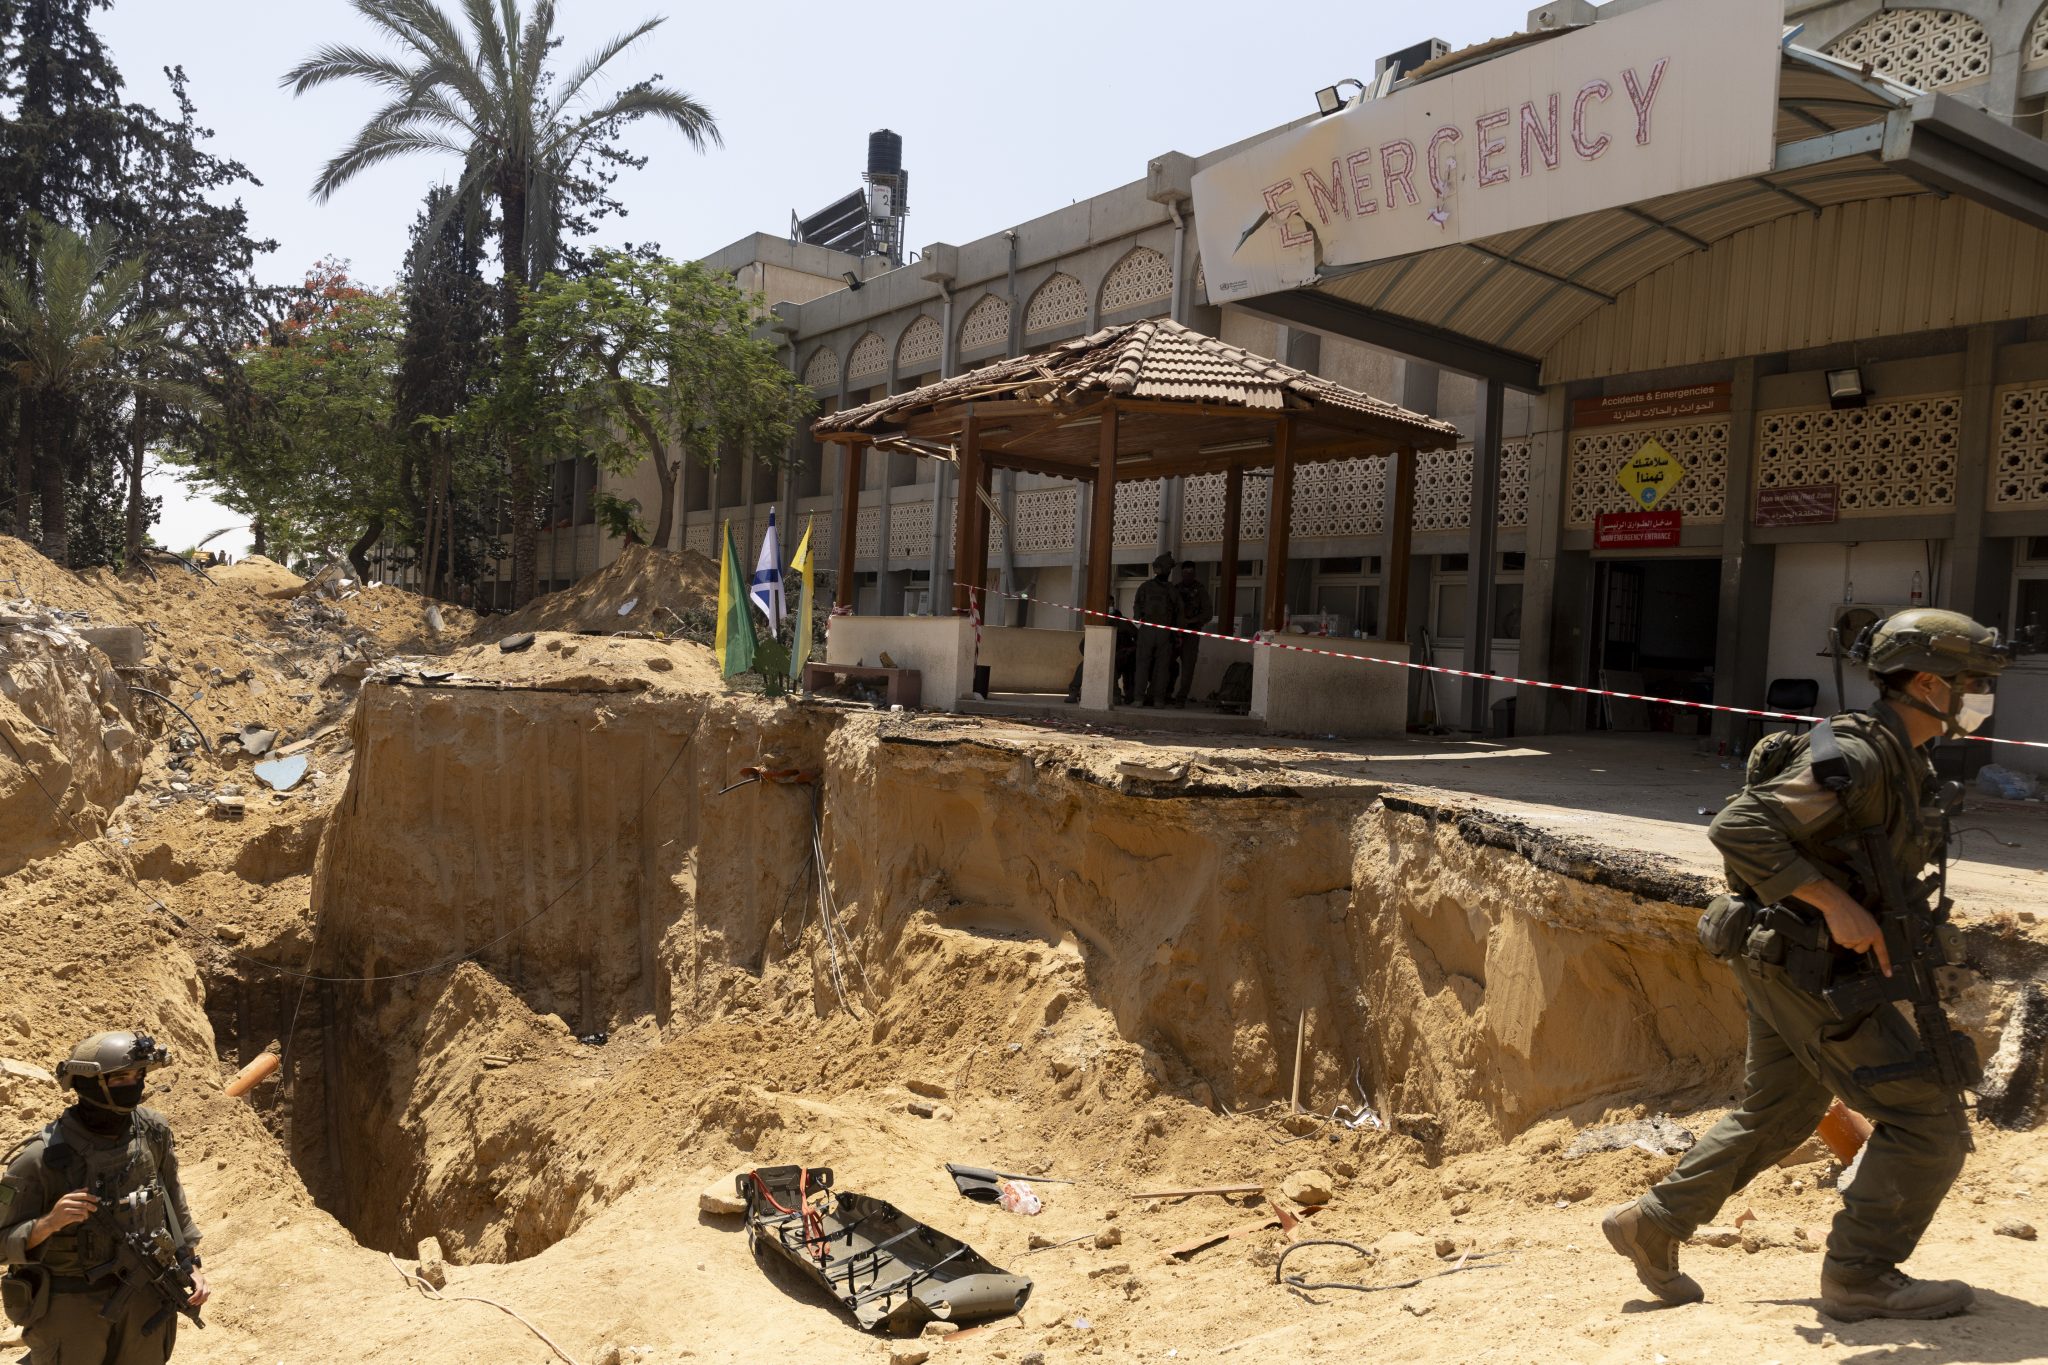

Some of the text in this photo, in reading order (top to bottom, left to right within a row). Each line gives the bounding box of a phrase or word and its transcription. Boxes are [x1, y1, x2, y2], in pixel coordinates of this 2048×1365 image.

[1261, 57, 1669, 249] EMERGENCY
[882, 194, 890, 207] 2
[1602, 386, 1715, 406] Accidents & Emergencies
[1679, 400, 1714, 413] الحوادث
[1613, 410, 1641, 421] الطارئة
[1632, 457, 1669, 468] سلامتك
[1636, 471, 1664, 484] تهمنا!
[1653, 519, 1673, 528] مدخل
[1614, 533, 1644, 542] EMERGENCY
[1644, 531, 1672, 541] ENTRANCE
